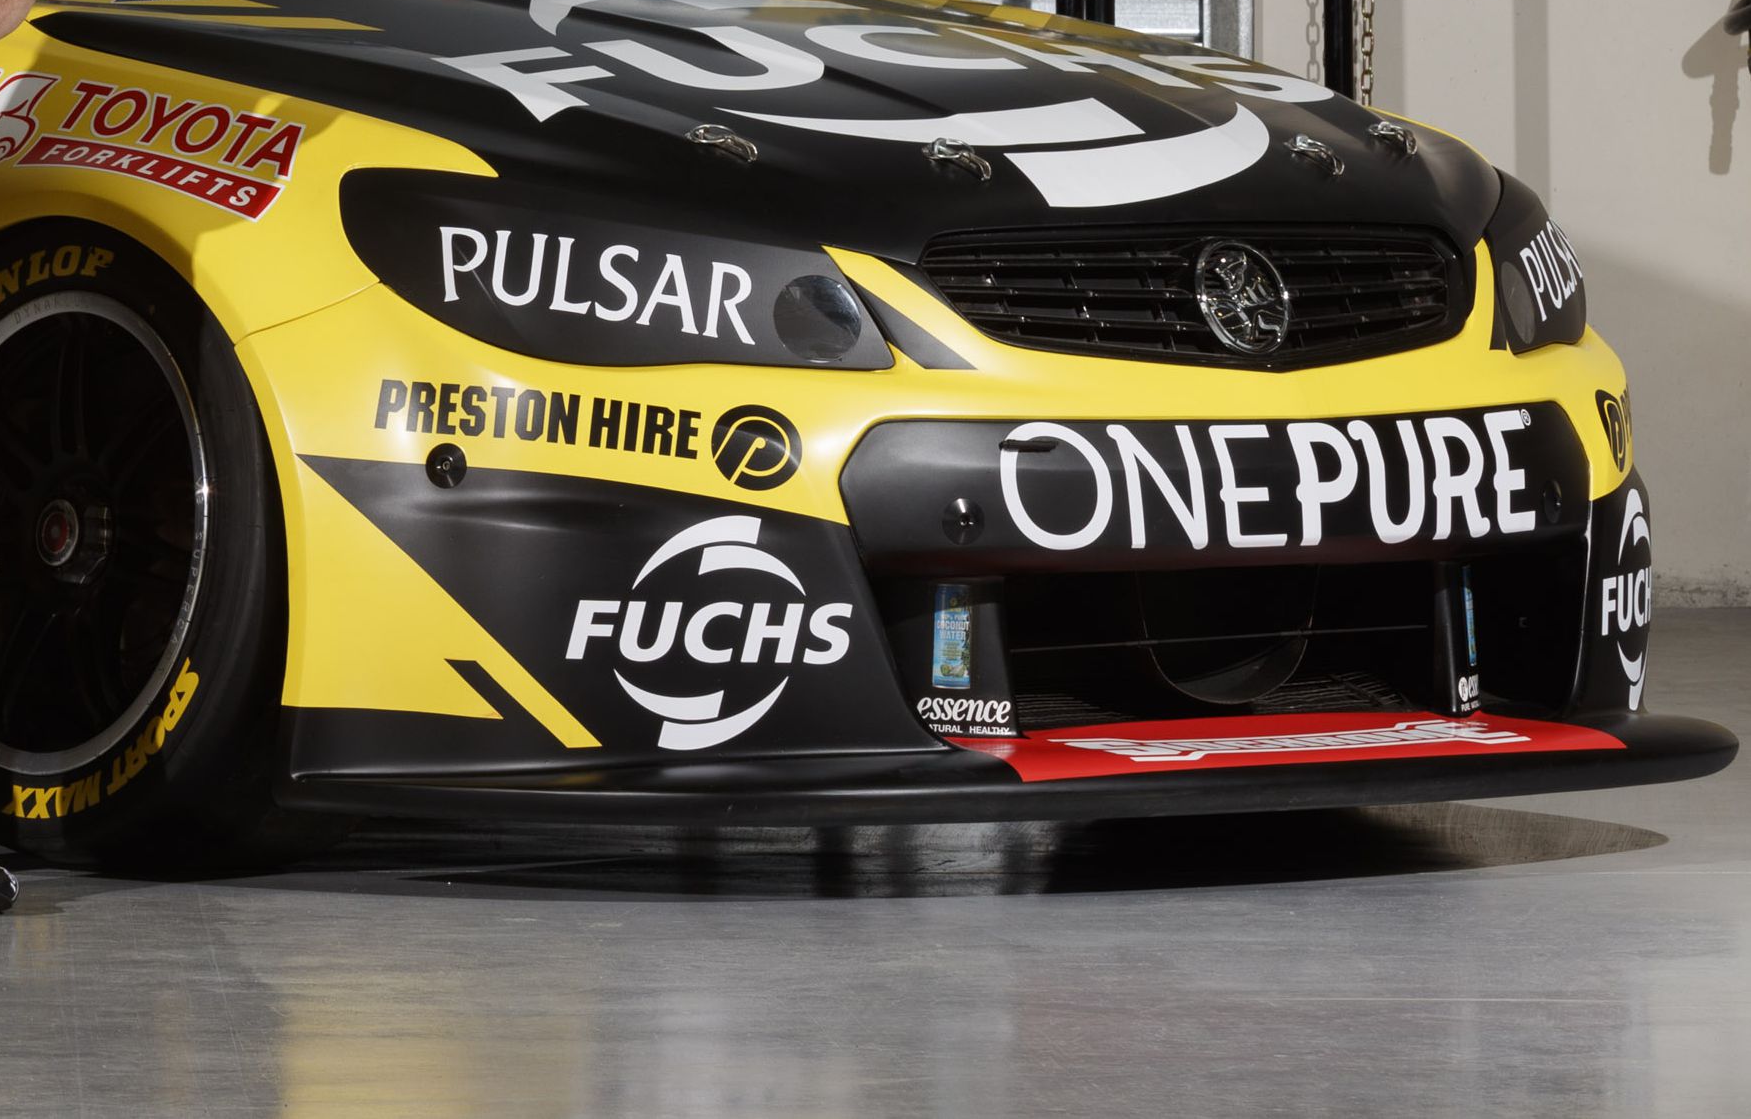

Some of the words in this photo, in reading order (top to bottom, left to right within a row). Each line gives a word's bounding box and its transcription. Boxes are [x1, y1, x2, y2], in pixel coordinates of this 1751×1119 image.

[431, 23, 1336, 124] FUCHS
[60, 81, 302, 180] TOYOTA
[40, 142, 261, 208] FORKLIFTS
[439, 225, 757, 347] PULSAR
[374, 378, 581, 446] PRESTON
[589, 396, 702, 461] HIRE
[999, 409, 1536, 552] ONEPURE
[565, 599, 853, 665] FUCHS
[1601, 565, 1652, 637] FUCH
[107, 657, 200, 796] SPORT
[917, 696, 1012, 724] essence
[2, 769, 102, 819] MAXX
